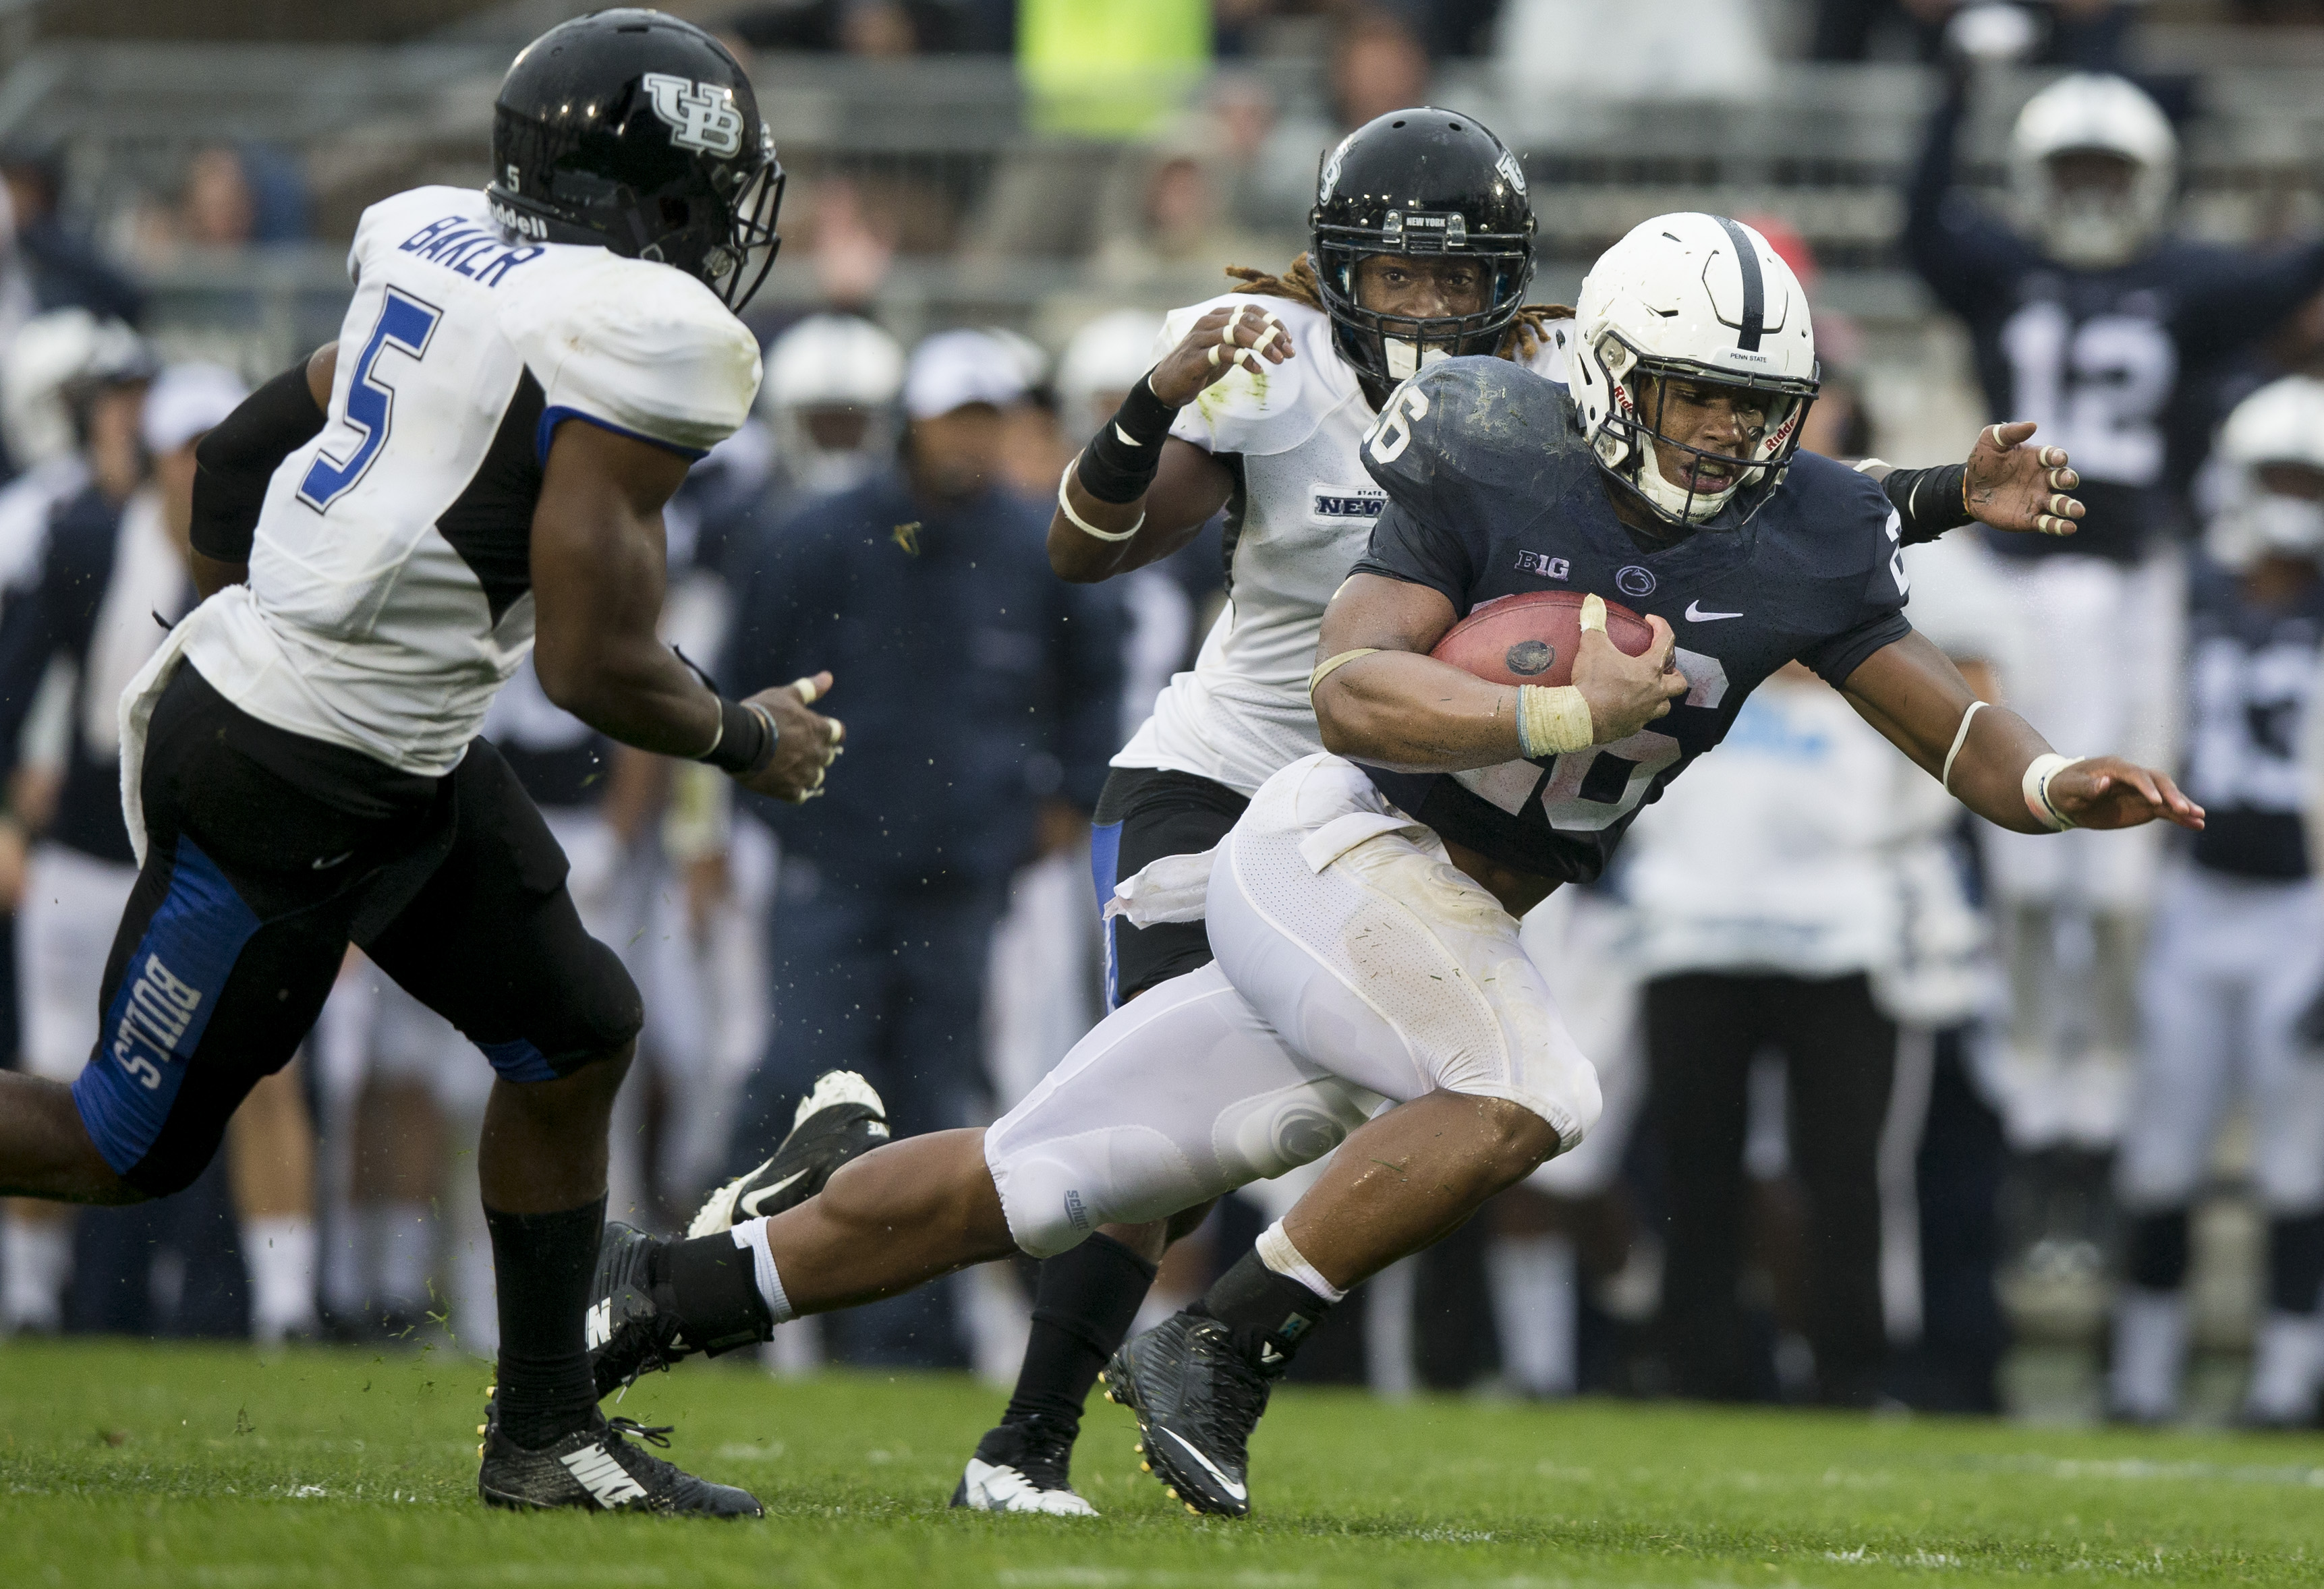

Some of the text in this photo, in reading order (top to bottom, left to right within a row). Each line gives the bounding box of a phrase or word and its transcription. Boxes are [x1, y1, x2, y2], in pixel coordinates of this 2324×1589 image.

[506, 164, 520, 194] 5
[397, 215, 545, 288] BAKER
[1406, 217, 1446, 227] NEW YORK
[1730, 352, 1748, 361] PENN
[1999, 301, 2176, 482] 12
[295, 283, 444, 516] 5
[113, 952, 202, 1090] BULLS
